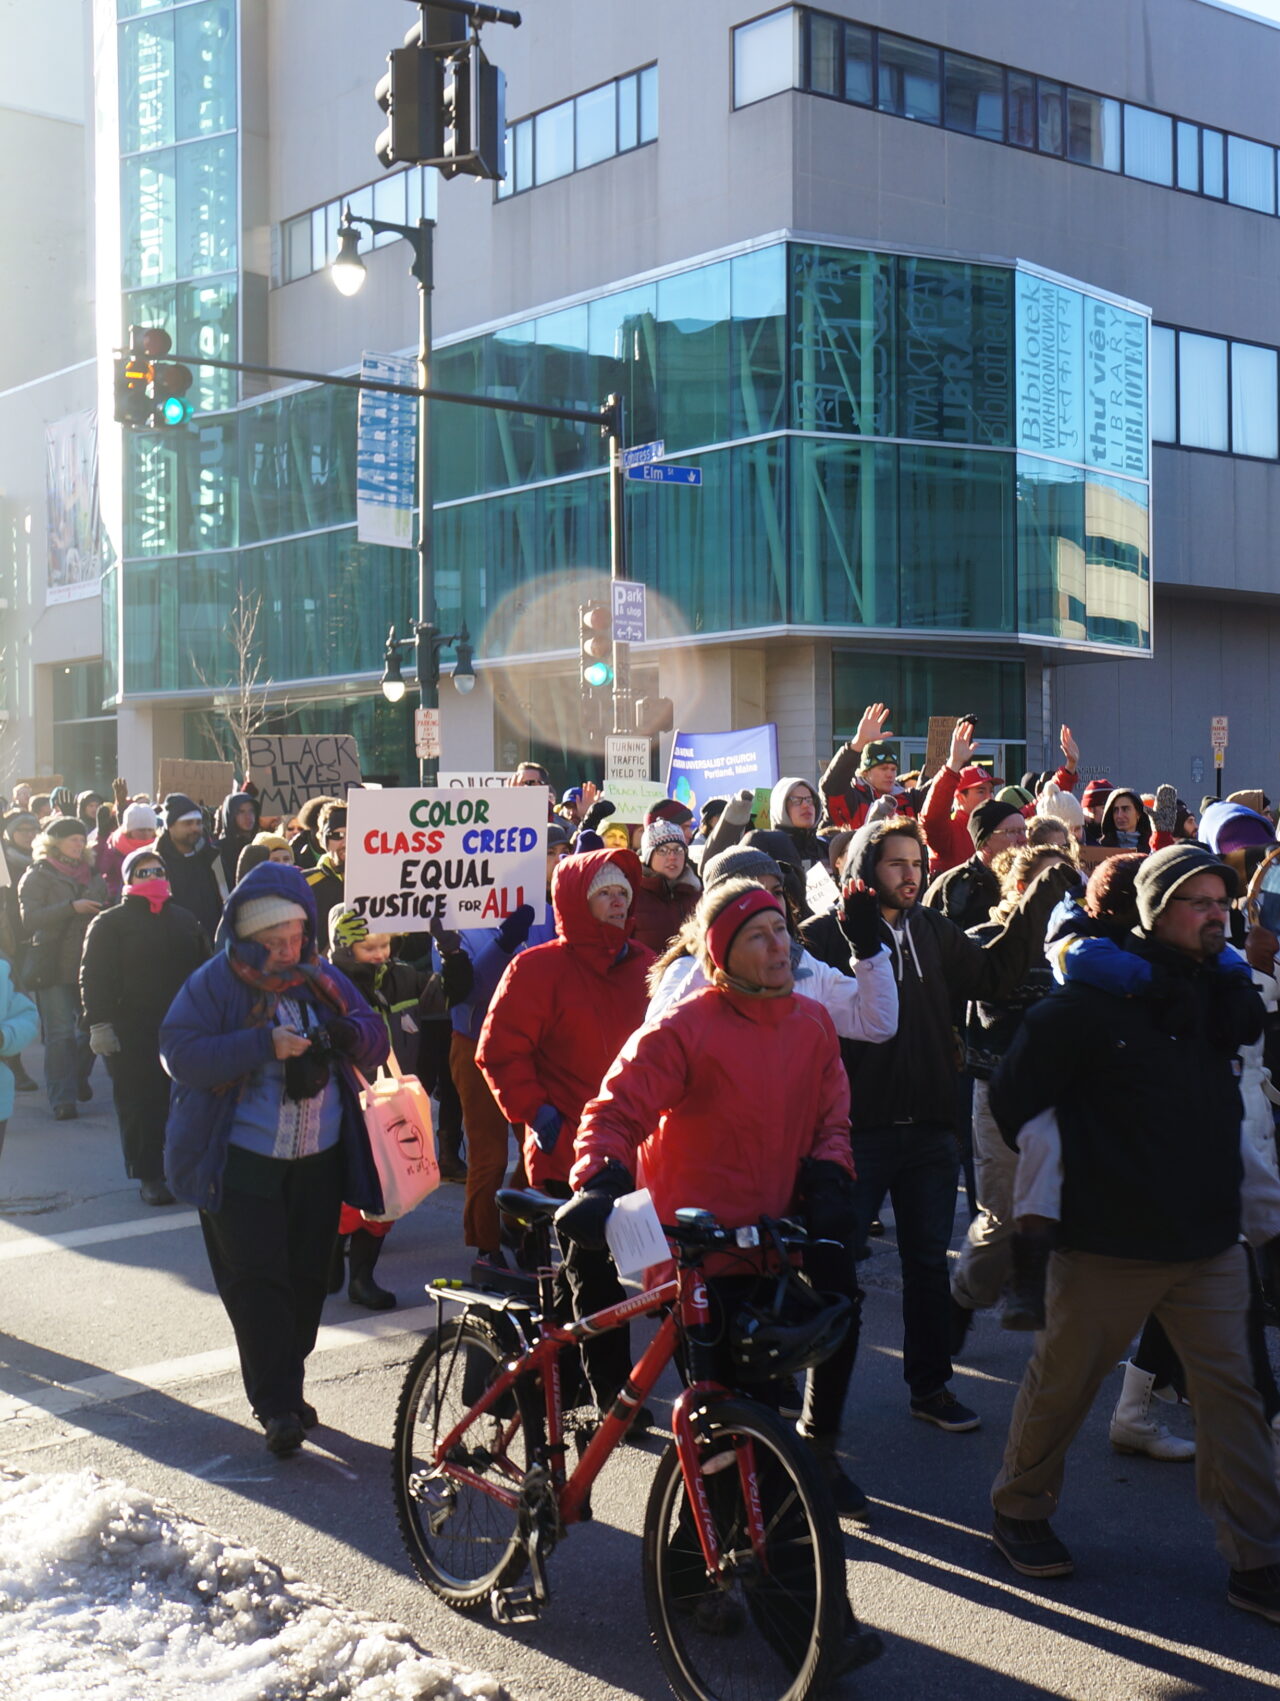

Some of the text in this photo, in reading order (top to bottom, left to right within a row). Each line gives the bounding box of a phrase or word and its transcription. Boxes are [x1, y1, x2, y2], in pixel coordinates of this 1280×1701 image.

[943, 262, 973, 440] LIBRARY
[976, 270, 1010, 445] Bibliothèque
[1021, 282, 1041, 446] Bibilotek
[1042, 287, 1056, 449] WIKHIKONIKUWAM
[1110, 308, 1124, 468] LIBRARY
[1124, 320, 1144, 473] BIBLIOTECA
[643, 465, 674, 480] Elm St
[615, 586, 642, 616] Park
[247, 736, 359, 768] BLACK
[611, 741, 647, 752] TURNING
[613, 755, 645, 766] TRAFFIC
[726, 752, 756, 764] CHURCH
[271, 764, 341, 787] LIVES
[610, 769, 647, 779] YIELD TO
[735, 764, 758, 775] Maine
[409, 799, 489, 828] COLOR
[617, 802, 648, 813] MATT
[364, 827, 538, 855] CLASS CREED
[400, 859, 495, 890] EQUAL
[353, 886, 525, 919] JUSTICE FOR ALL
[695, 1477, 717, 1551] ULTRA
